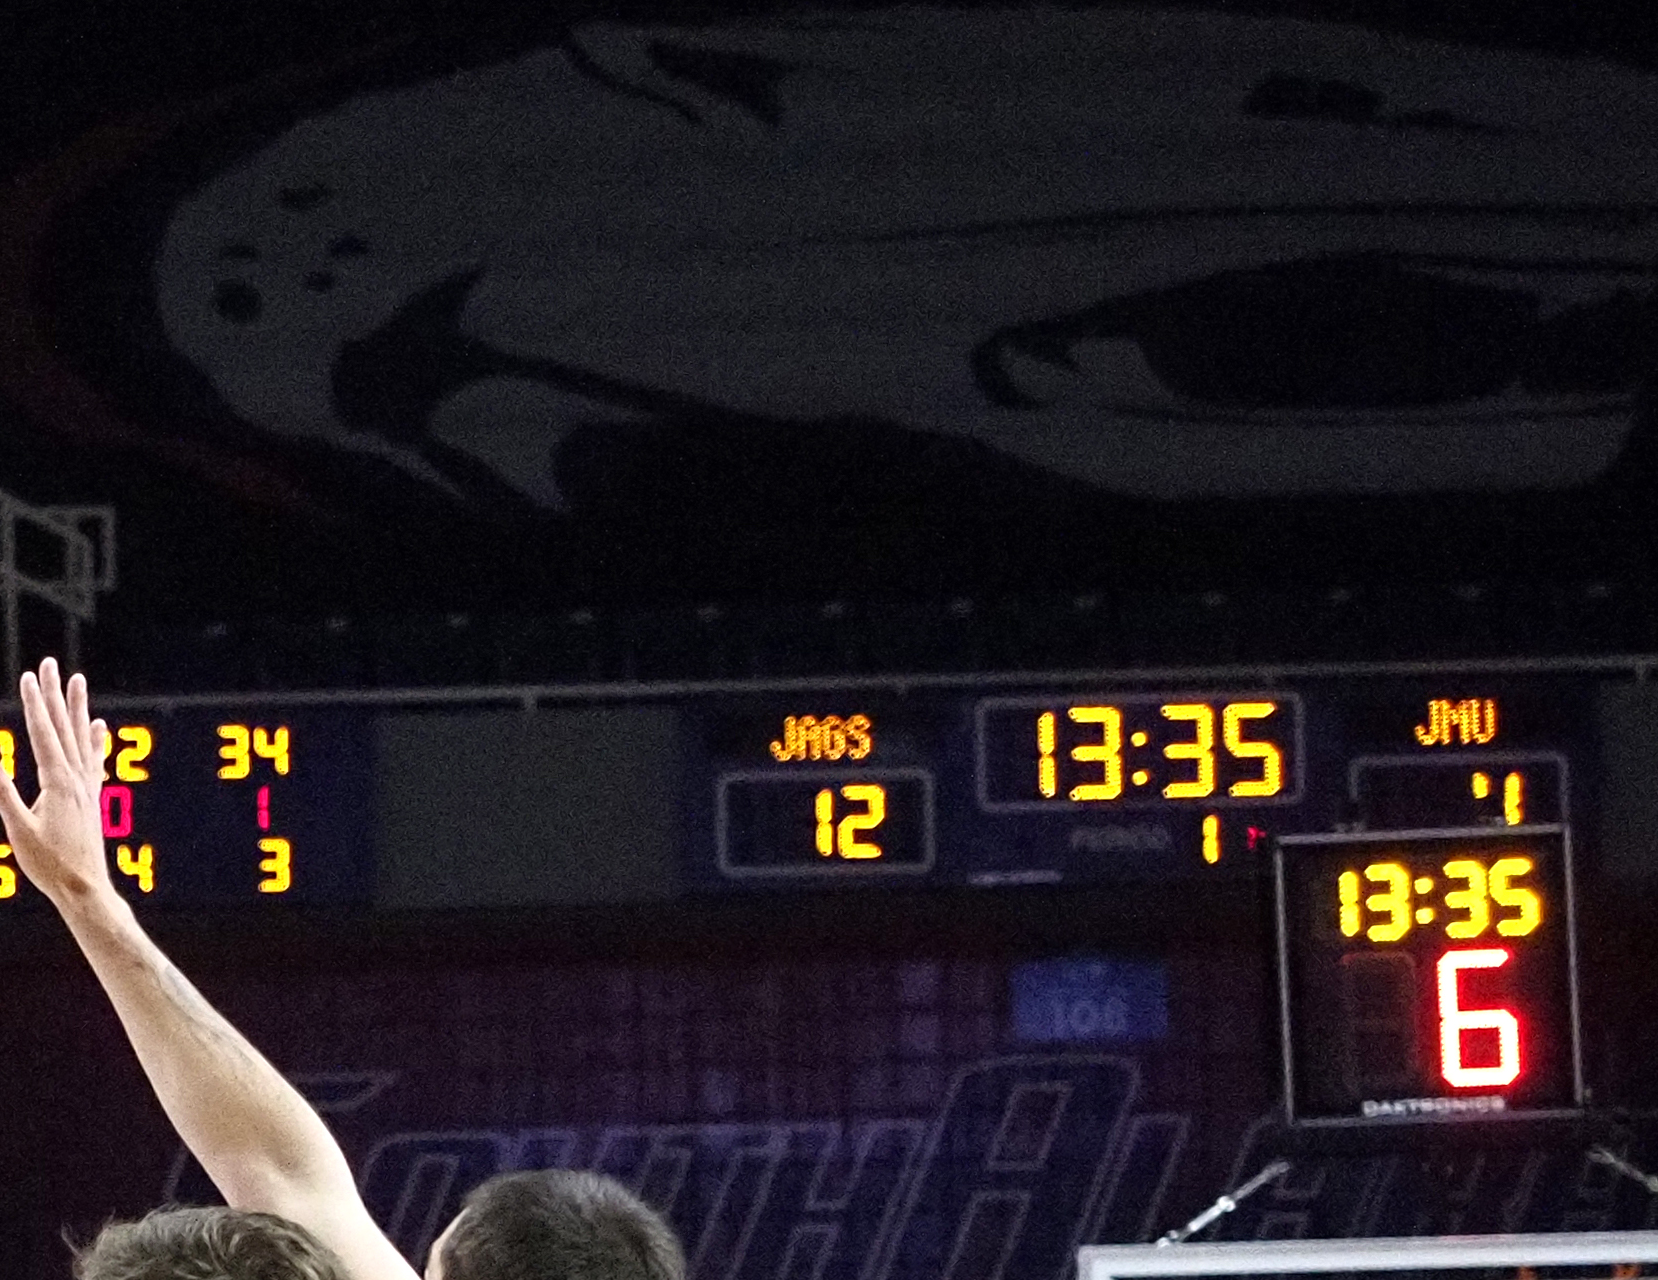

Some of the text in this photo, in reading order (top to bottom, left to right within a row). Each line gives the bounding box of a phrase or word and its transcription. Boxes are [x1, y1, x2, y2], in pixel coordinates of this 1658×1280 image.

[769, 713, 872, 762] JAGS
[1415, 698, 1499, 746] JMU
[102, 726, 152, 782] 2
[217, 724, 290, 779] 34
[1036, 701, 1284, 801] 13:35
[100, 784, 134, 838] 0
[256, 785, 271, 831] 1
[814, 783, 886, 860] 12
[1202, 813, 1220, 865] 1
[117, 843, 154, 893] 4
[257, 837, 292, 894] 3
[1338, 857, 1541, 942] 13:35
[1436, 947, 1522, 1089] 6
